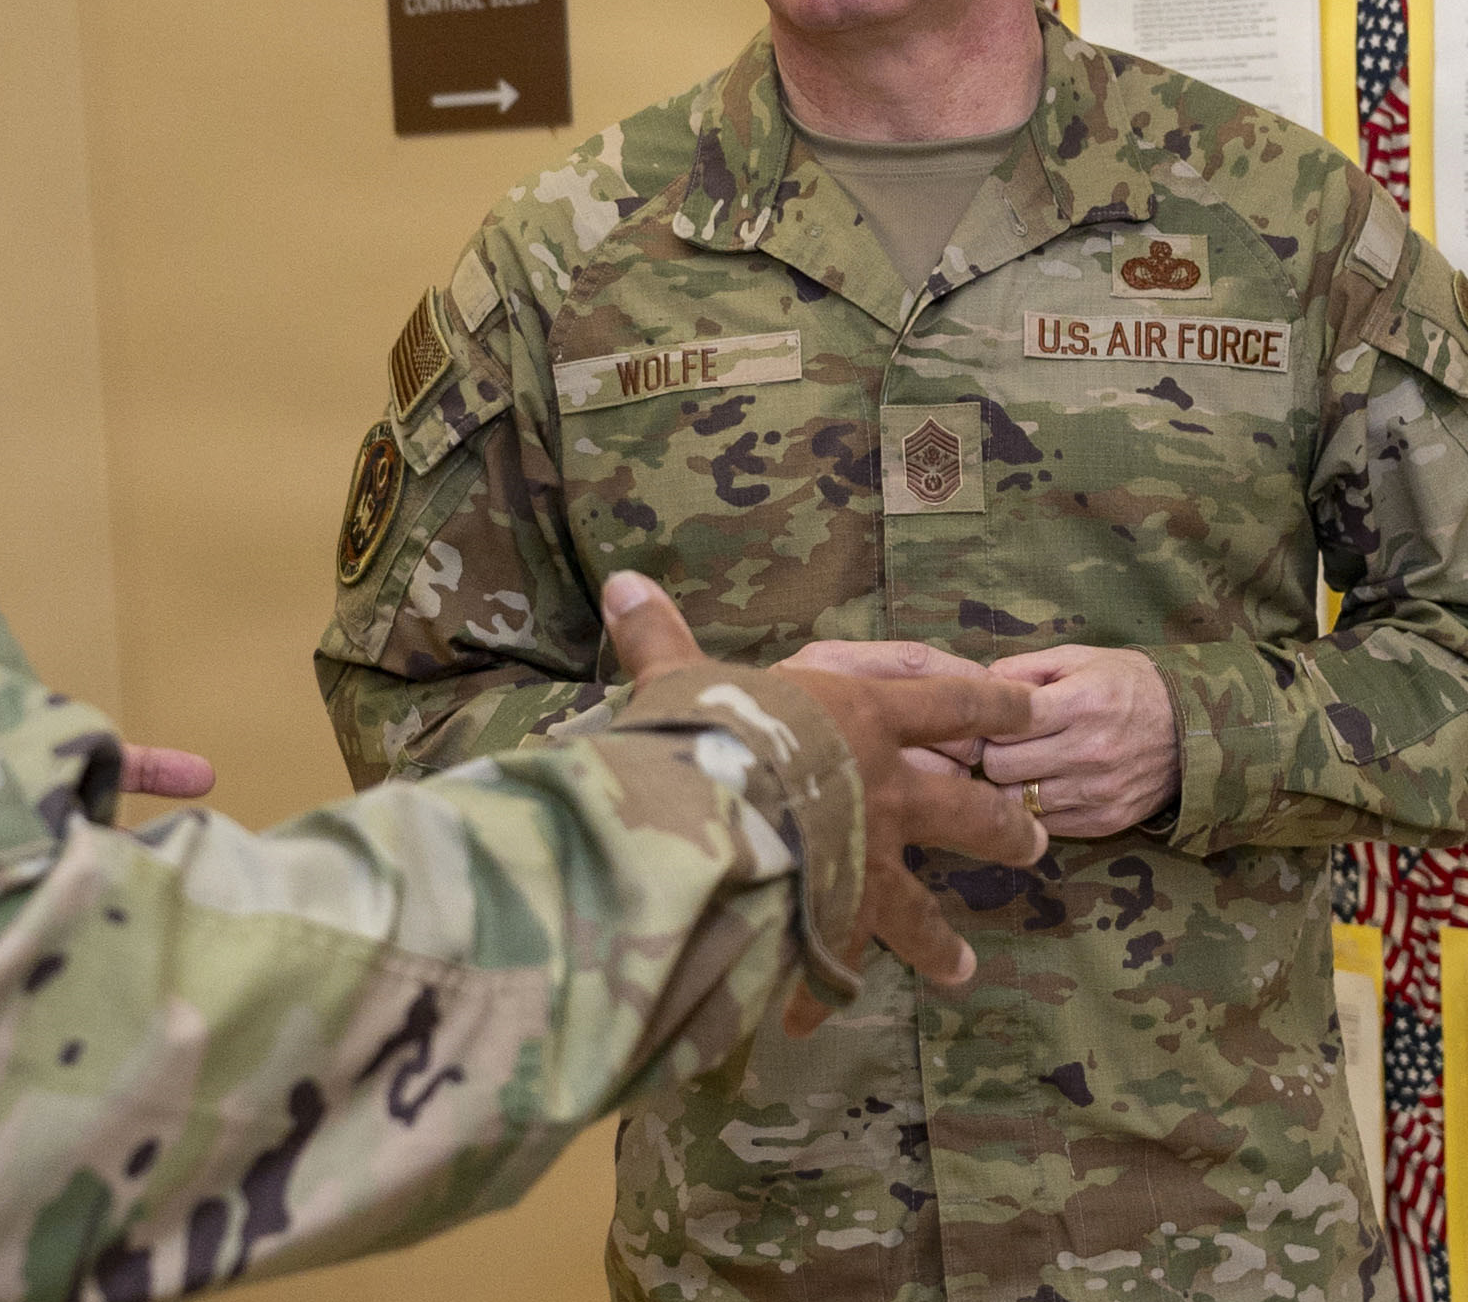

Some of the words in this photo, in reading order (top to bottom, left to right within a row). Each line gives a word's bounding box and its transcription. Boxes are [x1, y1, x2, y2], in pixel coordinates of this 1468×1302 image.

[1038, 316, 1099, 357] U.S.
[1106, 318, 1167, 359] AIR
[1177, 322, 1283, 369] FORCE
[615, 346, 719, 398] WOLFE
